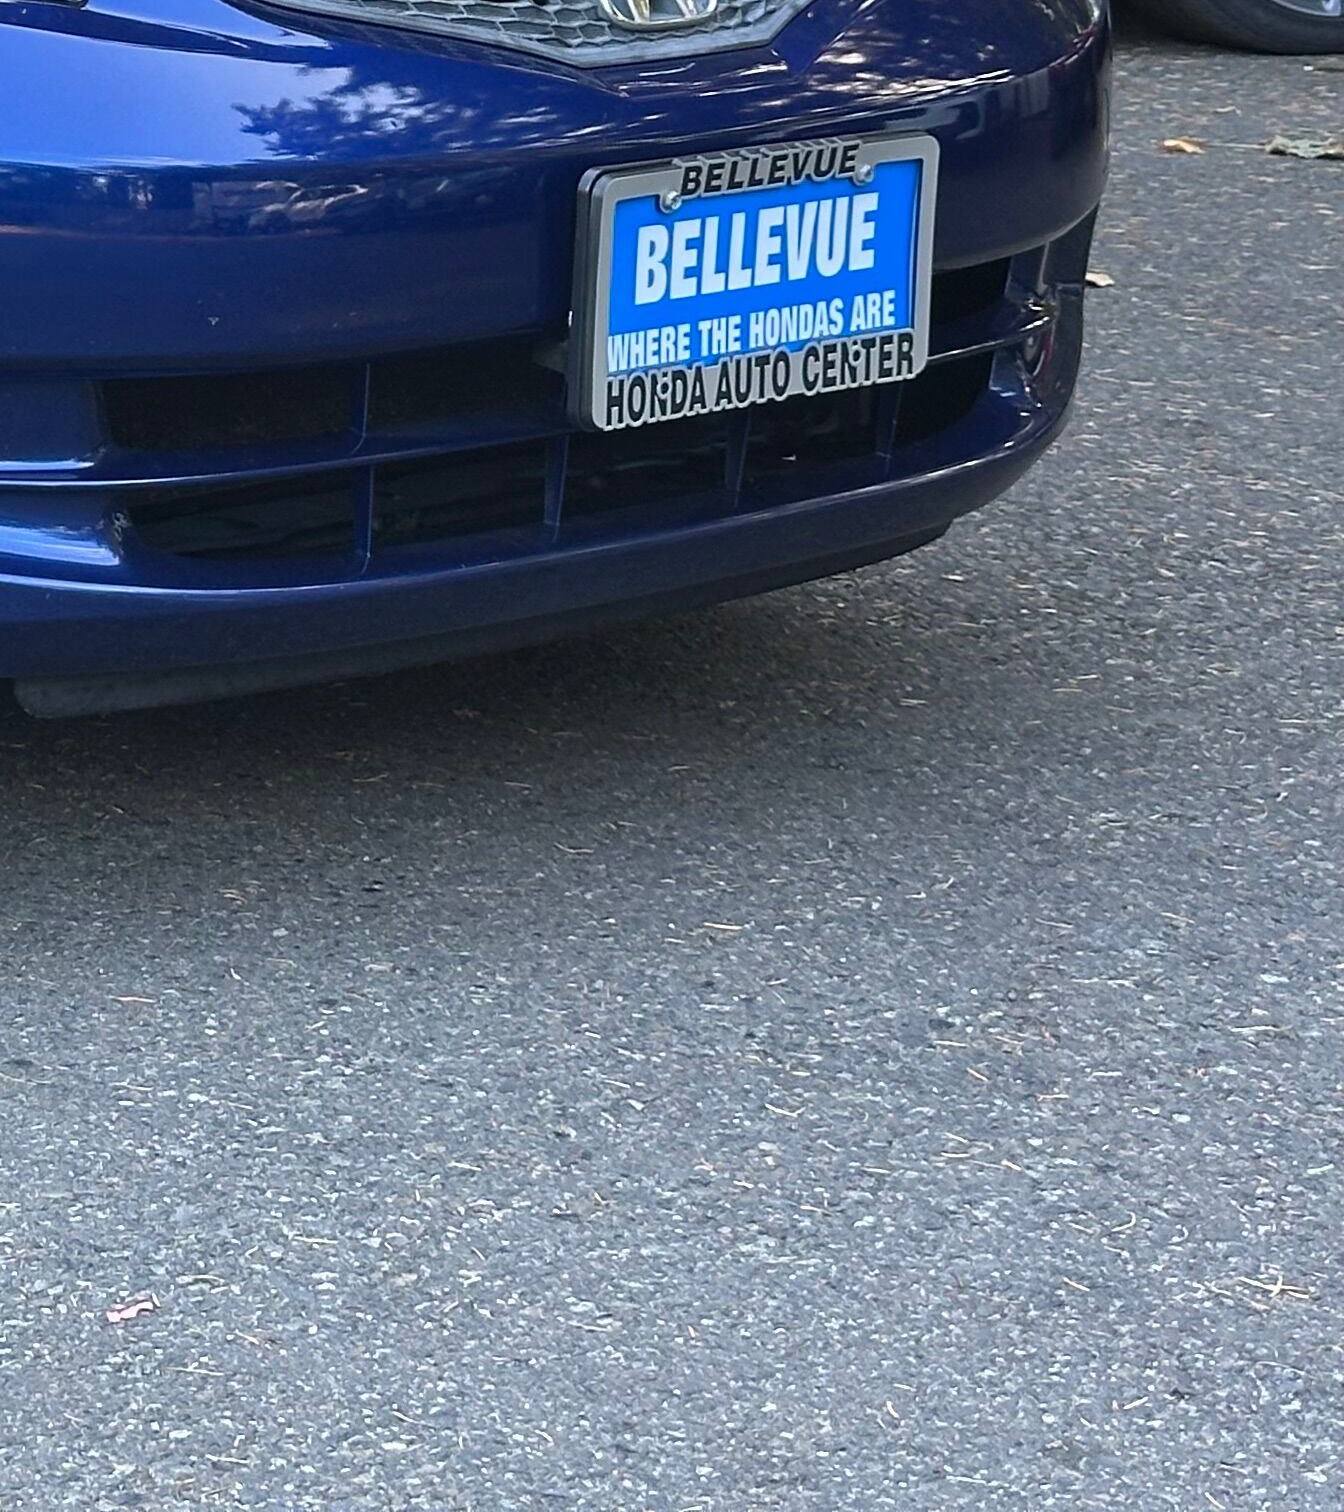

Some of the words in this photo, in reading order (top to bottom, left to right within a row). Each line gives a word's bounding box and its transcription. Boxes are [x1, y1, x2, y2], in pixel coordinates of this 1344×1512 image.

[680, 143, 860, 196] BELLEVUE
[634, 191, 880, 306] BELLEVUE
[607, 323, 691, 373] WHERE
[698, 315, 741, 357] THE
[748, 297, 845, 349] HONDAS
[850, 289, 896, 332] ARE
[605, 364, 708, 427] HONDA
[714, 350, 791, 408] AUTO
[802, 332, 914, 392] CENTER
